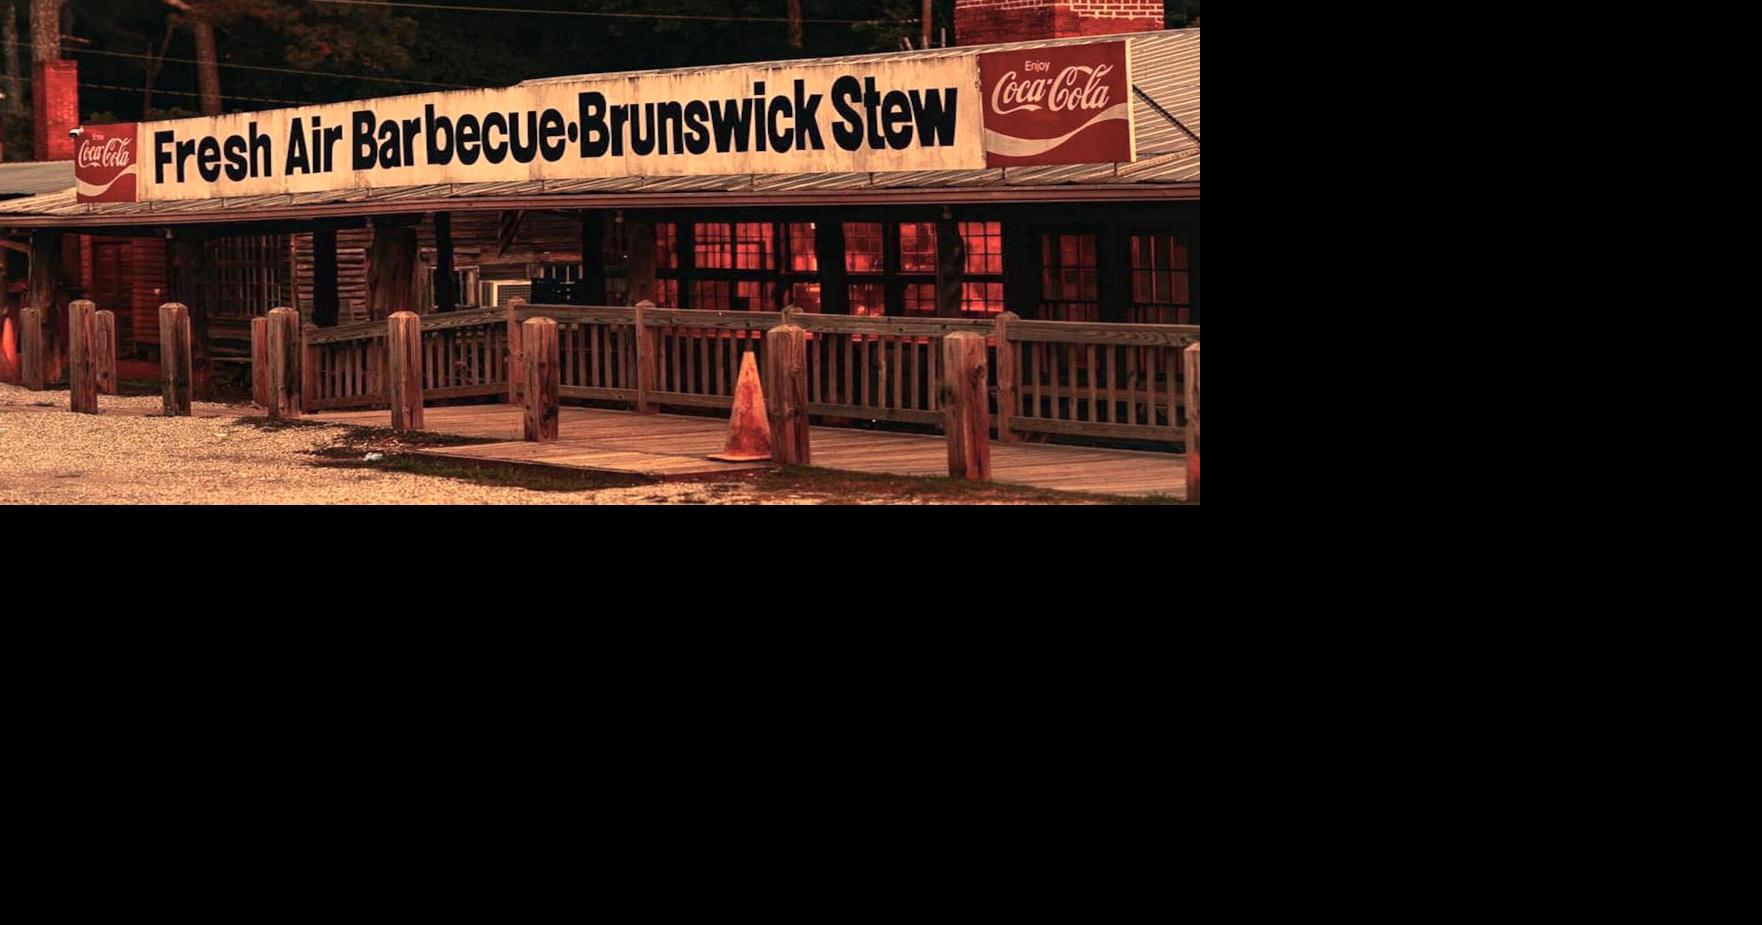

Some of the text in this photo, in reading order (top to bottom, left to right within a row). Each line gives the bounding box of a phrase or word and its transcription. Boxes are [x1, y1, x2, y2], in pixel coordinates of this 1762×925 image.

[1024, 60, 1050, 73] Enjoy
[991, 63, 1115, 115] Coca-Cola
[154, 121, 272, 184] Fresh
[285, 116, 343, 176] Air
[831, 75, 958, 152] Stew
[78, 137, 132, 168] Coca-Cola
